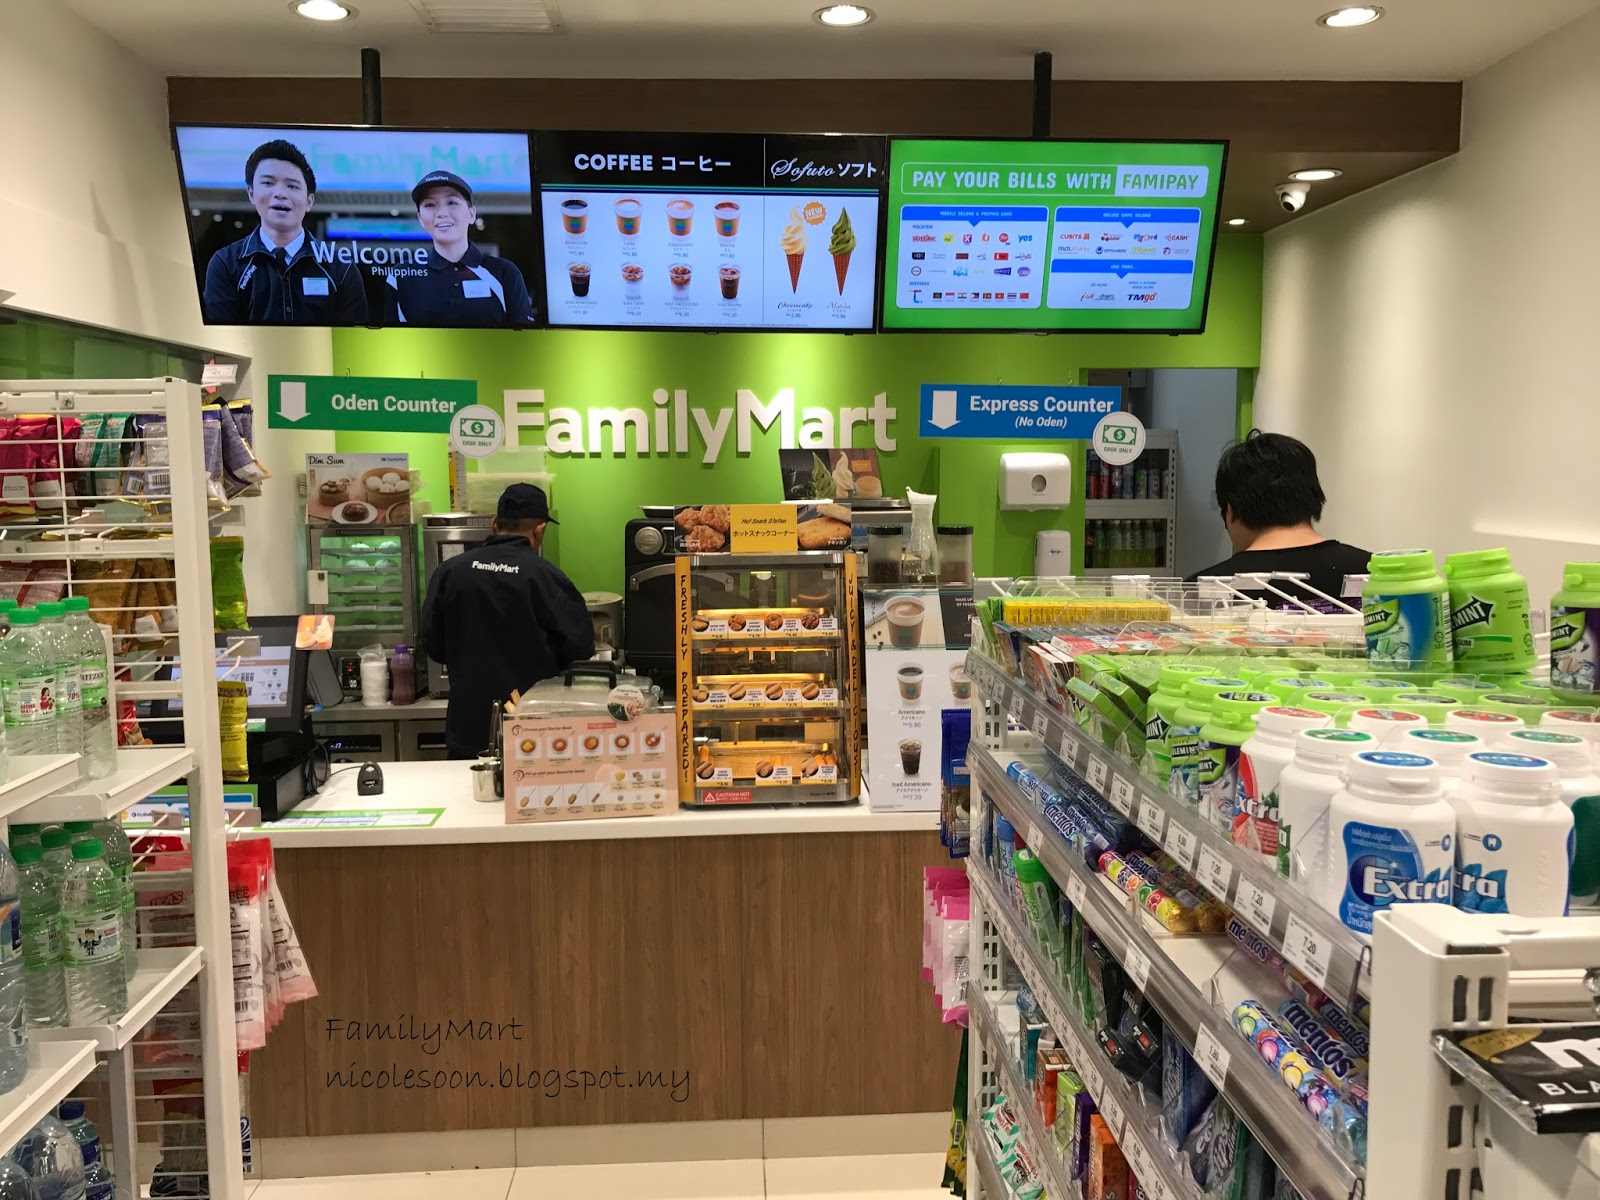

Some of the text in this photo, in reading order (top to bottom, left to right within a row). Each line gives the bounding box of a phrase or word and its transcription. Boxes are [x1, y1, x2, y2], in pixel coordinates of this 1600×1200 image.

[574, 153, 731, 172] COFFEE コーヒー
[770, 157, 877, 182] Sofuto ソフト
[912, 171, 1199, 190] PAY YOUR BILLS WITH FAMIPAY
[805, 206, 823, 218] NEW
[1018, 234, 1033, 243] yes
[311, 240, 429, 265] Welcome
[371, 266, 429, 279] Philippines
[777, 301, 813, 310] Cheesecake
[826, 301, 851, 310] Matcha
[331, 393, 457, 413] Oden Counter
[970, 395, 1114, 415] Express Counter
[503, 387, 898, 465] FamilyMart
[1014, 416, 1067, 429] (No Oden)
[308, 455, 345, 465] Dim Sum
[732, 529, 796, 537] ホットスナックコーナー
[472, 560, 519, 574] FamilyMart
[847, 577, 856, 630] JUICY
[679, 574, 690, 783] FRESHLY PREPARED!
[850, 656, 859, 779] DELICIOUS!
[1045, 804, 1077, 839] mentos
[1177, 833, 1187, 846] 6.50
[1127, 853, 1162, 886] mentos
[1210, 860, 1222, 875] 7.20
[1362, 865, 1450, 901] Extra
[1251, 889, 1264, 907] 7.20
[1228, 918, 1269, 962] mentos
[1303, 936, 1317, 955] 7.20
[1122, 988, 1139, 1015] HALLS
[1284, 1003, 1355, 1079] mentos
